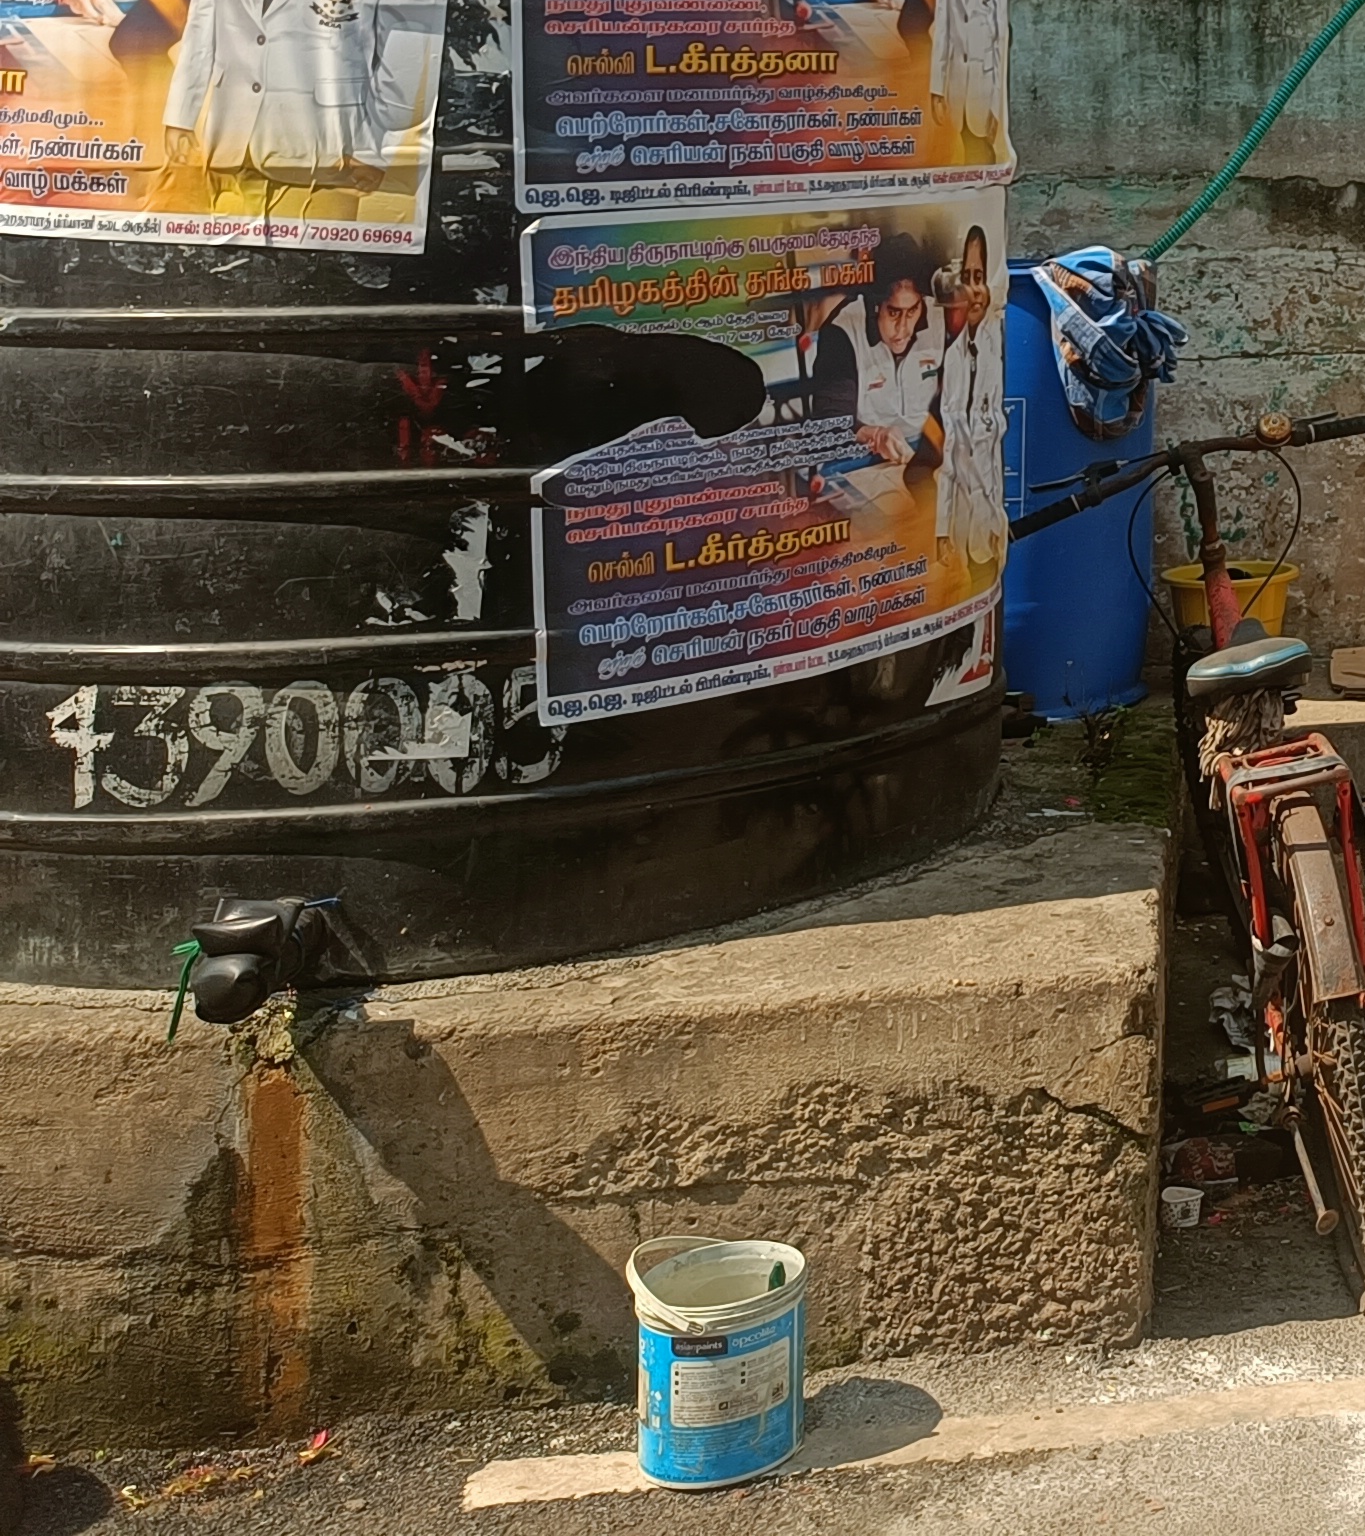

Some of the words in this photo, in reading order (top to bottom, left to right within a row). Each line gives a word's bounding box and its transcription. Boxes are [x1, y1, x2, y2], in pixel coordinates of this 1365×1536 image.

[567, 47, 636, 77] செல்வி
[846, 106, 923, 134] நண்பர்கள்
[28, 135, 144, 162] நண்பர்கள்
[729, 138, 774, 170] நகர்
[778, 137, 824, 167] பகுதி
[53, 170, 129, 196] மக்கள்
[362, 228, 413, 246] 69694
[547, 242, 624, 274] இந்திய
[626, 235, 745, 268] திருநாட்டிற்கு
[748, 229, 817, 256] பெருமை
[551, 266, 738, 319] தமிழகத்தின்
[744, 260, 812, 300] தங்க
[820, 252, 877, 287] மகள்
[587, 550, 656, 585] செல்வி
[858, 553, 929, 592] நண்பர்கள்
[747, 620, 795, 655] நகர்
[797, 609, 842, 646] பகுதி
